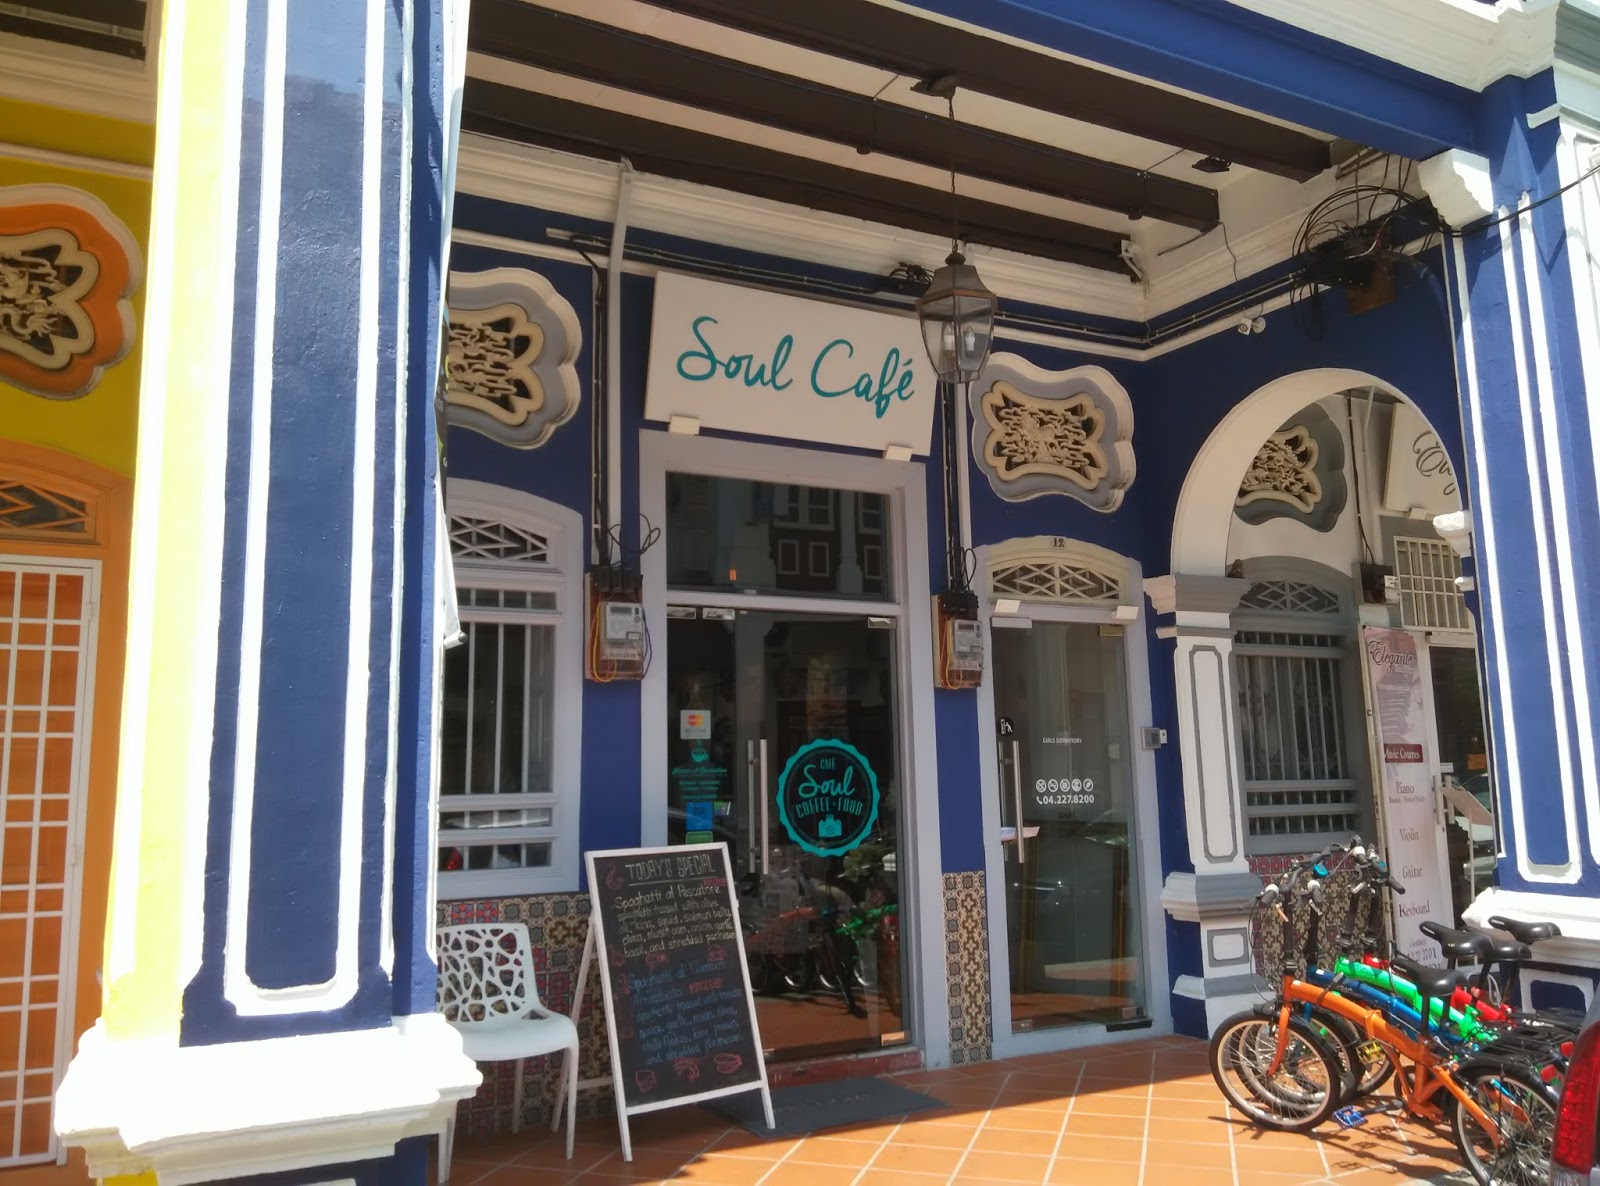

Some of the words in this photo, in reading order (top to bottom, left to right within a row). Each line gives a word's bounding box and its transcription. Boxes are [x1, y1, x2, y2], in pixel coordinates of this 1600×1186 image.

[676, 315, 794, 391] Soul
[810, 338, 915, 419] Café
[1053, 537, 1065, 548] 12
[1369, 640, 1414, 674] Elegante
[798, 764, 856, 798] Soul
[1396, 781, 1415, 795] Piano
[795, 797, 831, 818] COFFEE
[838, 797, 863, 816] FOOD
[1399, 827, 1420, 841] Violin
[677, 854, 716, 878] SPECIAL
[1402, 865, 1423, 879] Guitar
[614, 890, 662, 914] Spaghetti
[678, 884, 721, 898] Pescatore
[1398, 900, 1431, 918] Keyboard
[650, 939, 665, 951] and
